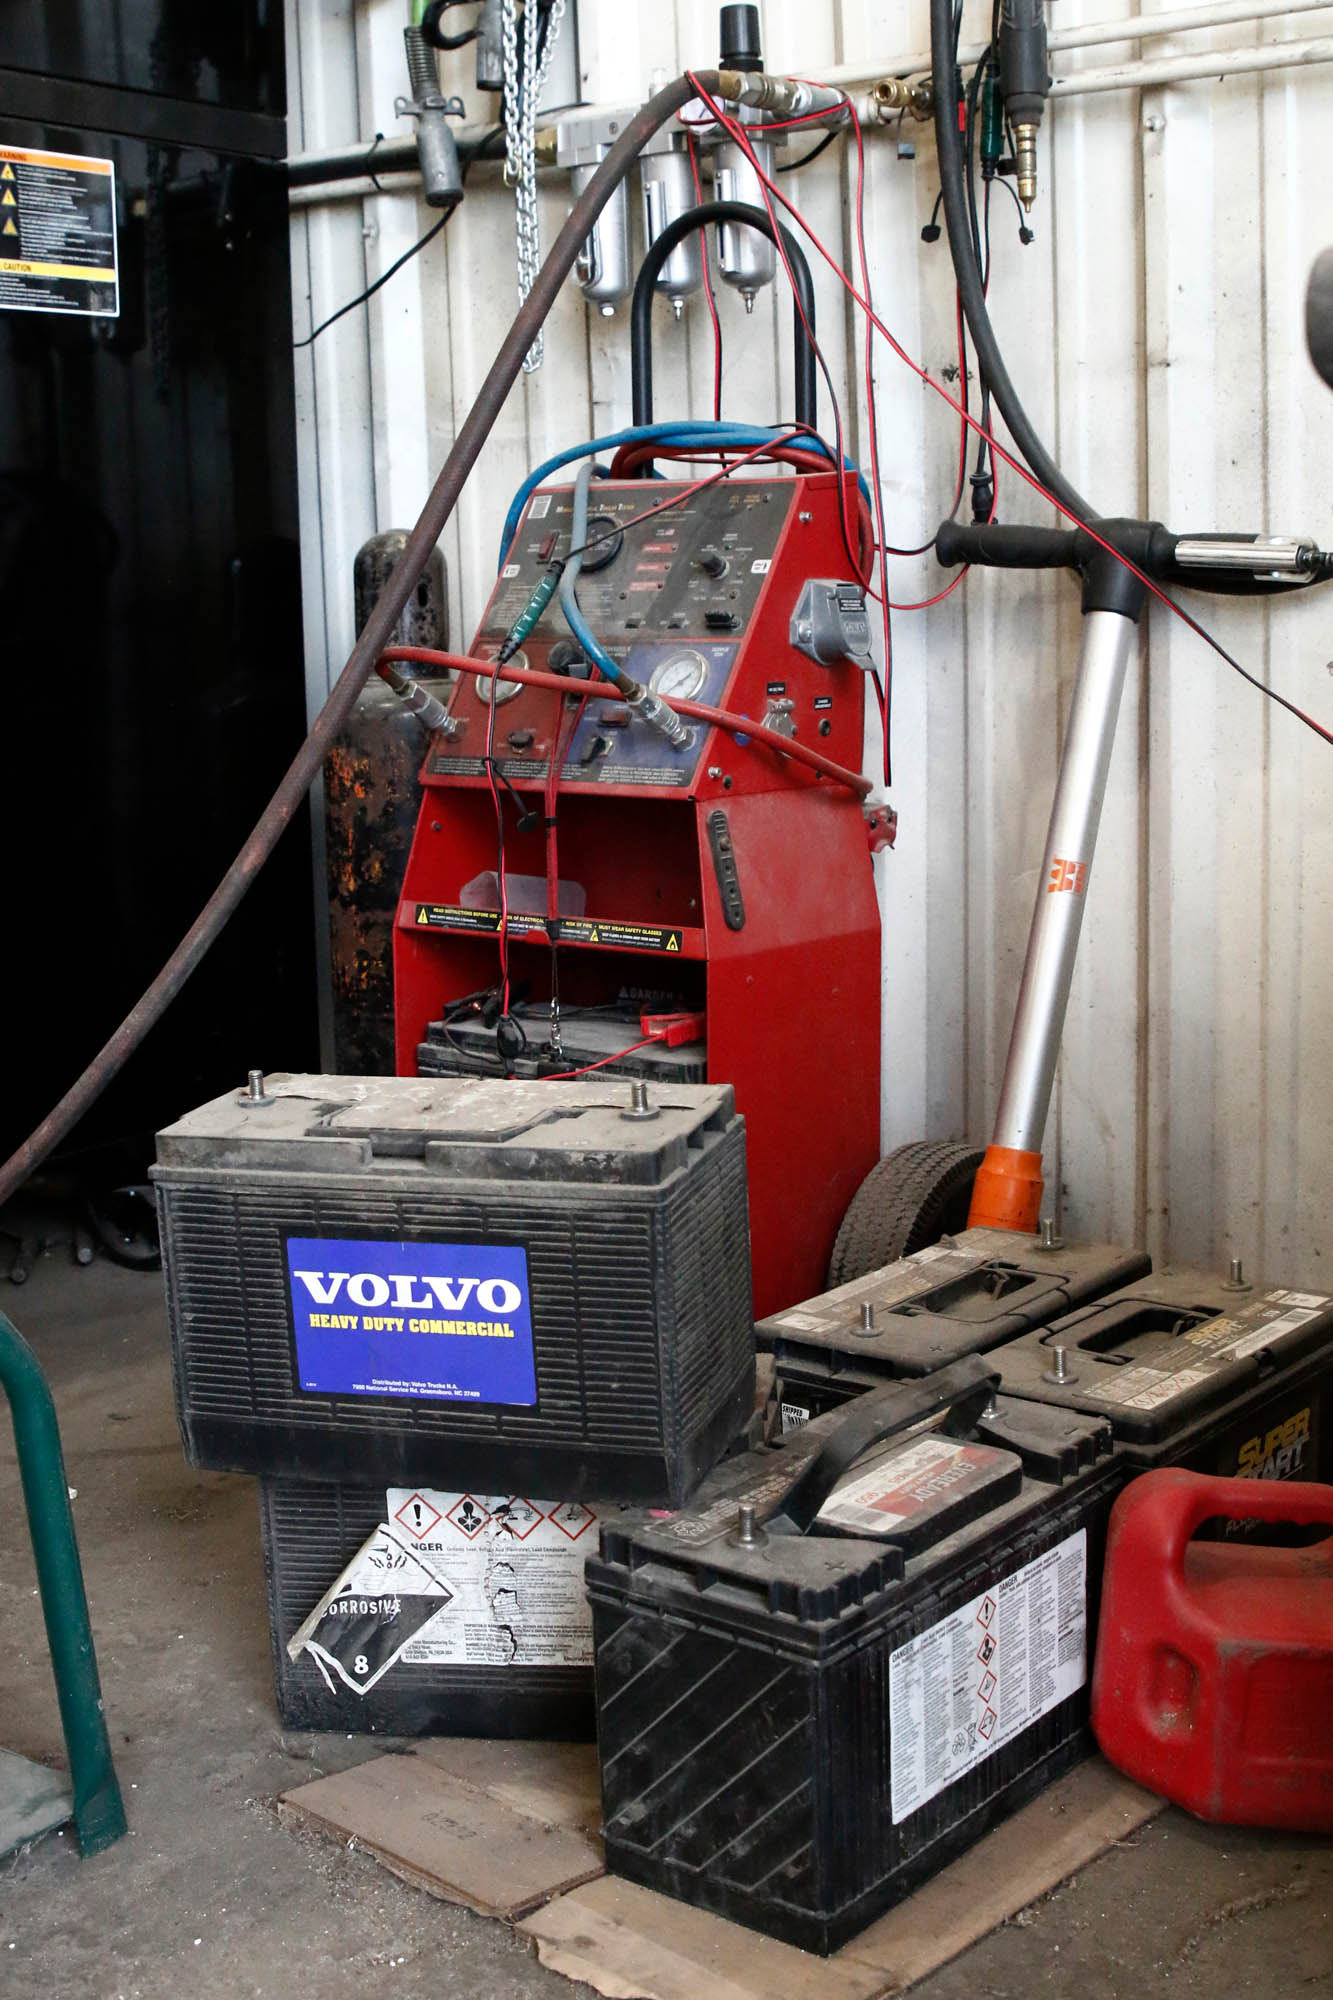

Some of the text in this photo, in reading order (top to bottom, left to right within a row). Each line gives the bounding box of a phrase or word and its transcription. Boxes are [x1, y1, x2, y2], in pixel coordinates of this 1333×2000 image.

[3, 262, 32, 273] CAUTION
[293, 1270, 522, 1314] VOLVO
[309, 1313, 515, 1338] HEAVY DUTY COMMERCIAL
[782, 1405, 803, 1417] SHIPPED
[1236, 1407, 1311, 1475] SUPER
[909, 1462, 977, 1503] EVEREADY
[411, 1542, 443, 1552] NGER
[998, 1574, 1018, 1593] DANGER
[321, 1599, 402, 1618] ORROSIVE
[892, 1642, 914, 1663] DANGER
[353, 1654, 370, 1674] 8
